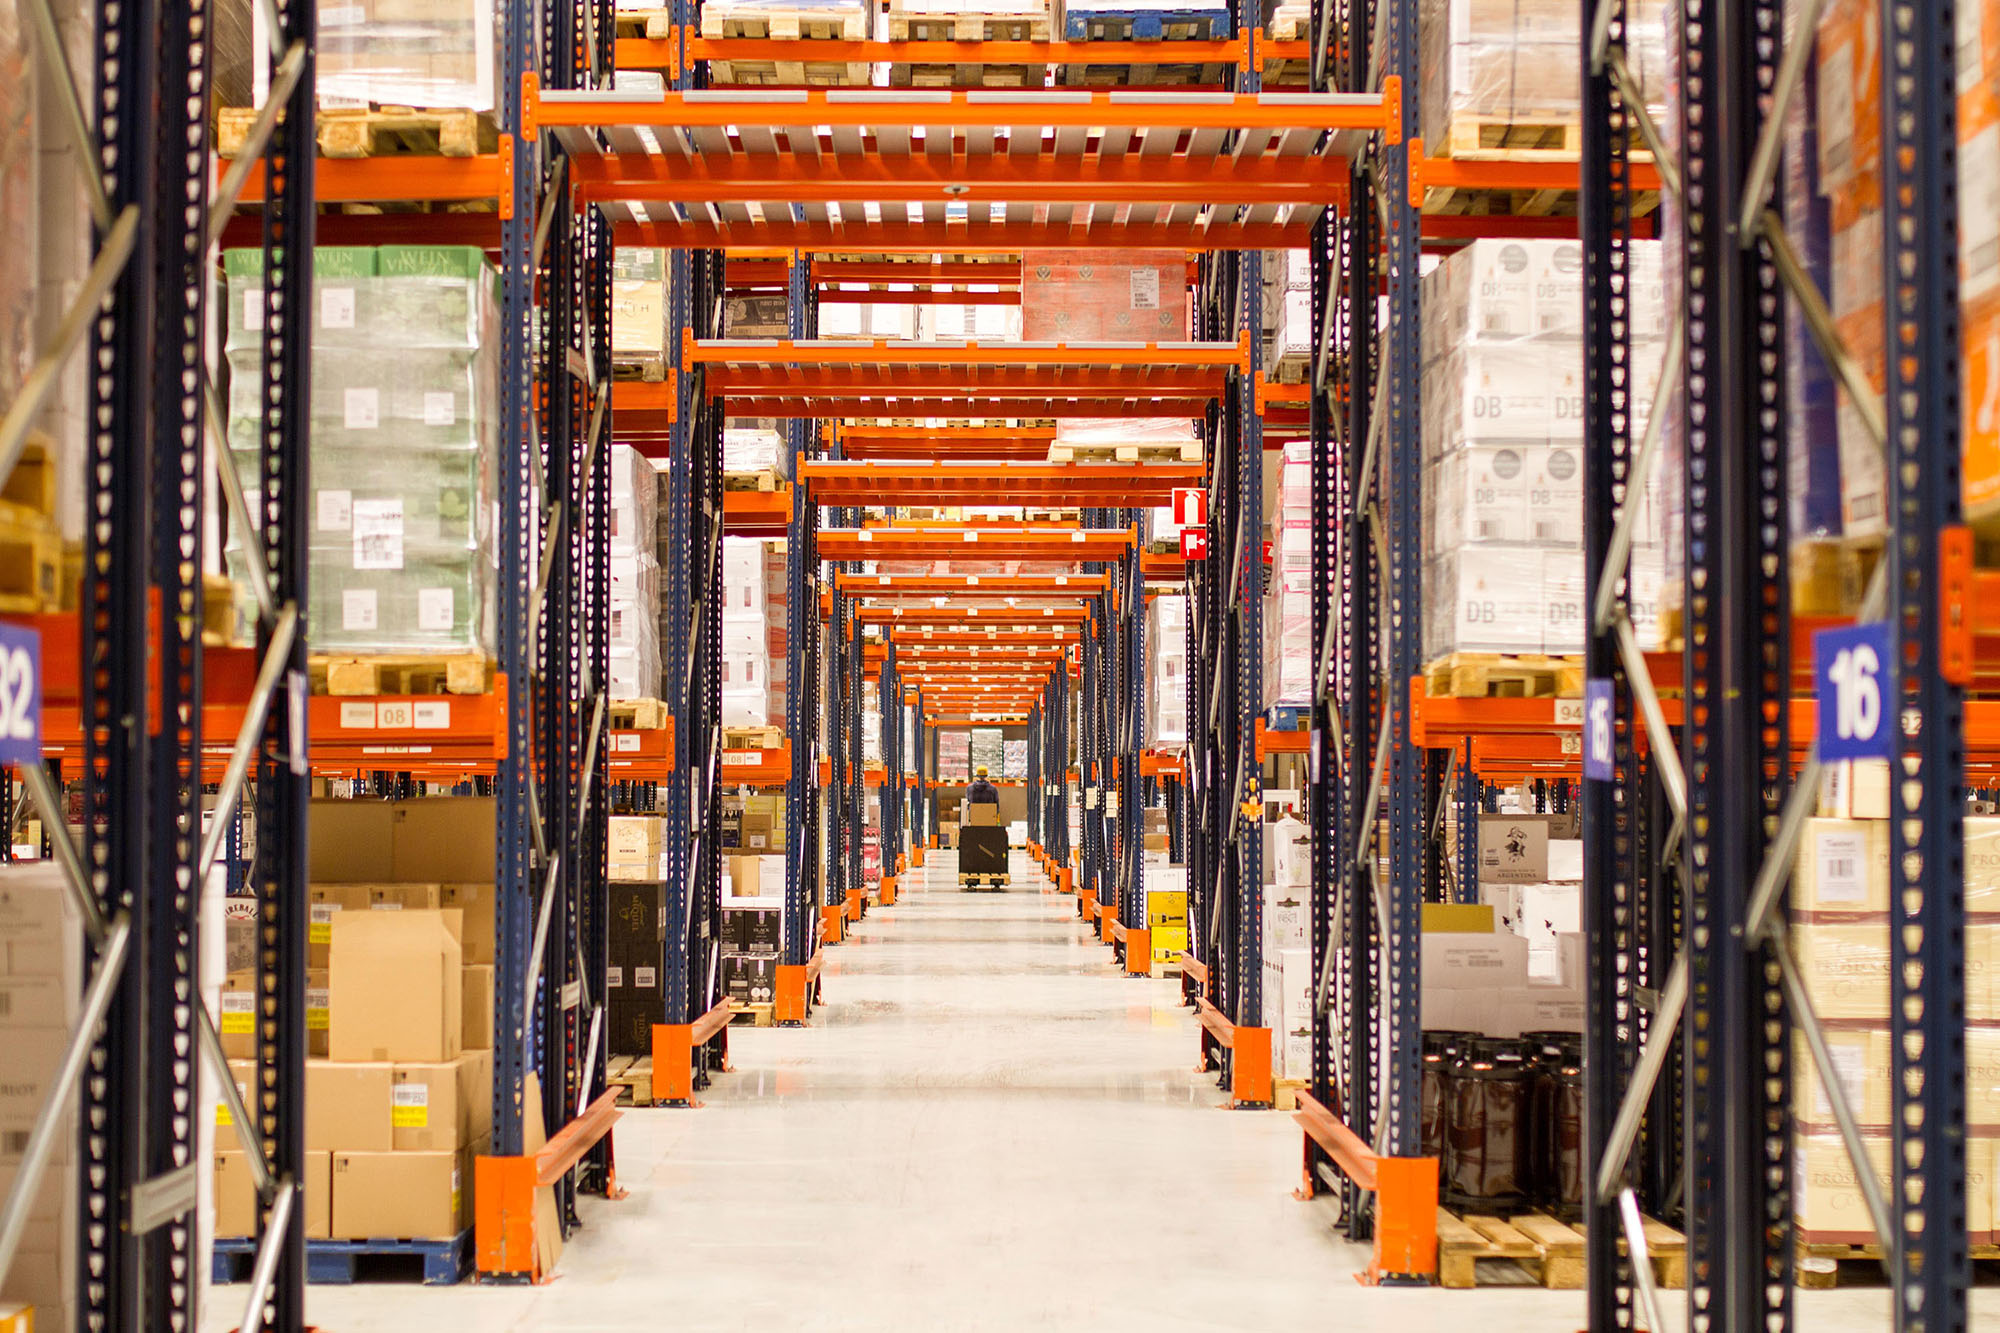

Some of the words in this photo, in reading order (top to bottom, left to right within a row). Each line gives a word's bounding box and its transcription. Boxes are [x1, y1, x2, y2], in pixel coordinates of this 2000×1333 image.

[1537, 283, 1558, 298] DB
[1474, 395, 1502, 419] DB
[1556, 396, 1584, 419] DB
[1475, 488, 1496, 504] DB
[1530, 489, 1551, 505] DB
[1467, 601, 1496, 623] DB
[1828, 642, 1881, 742] 16
[384, 709, 406, 725] 08
[1560, 705, 1585, 721] 94
[730, 755, 742, 764] 08
[631, 894, 639, 932] MIQUEL
